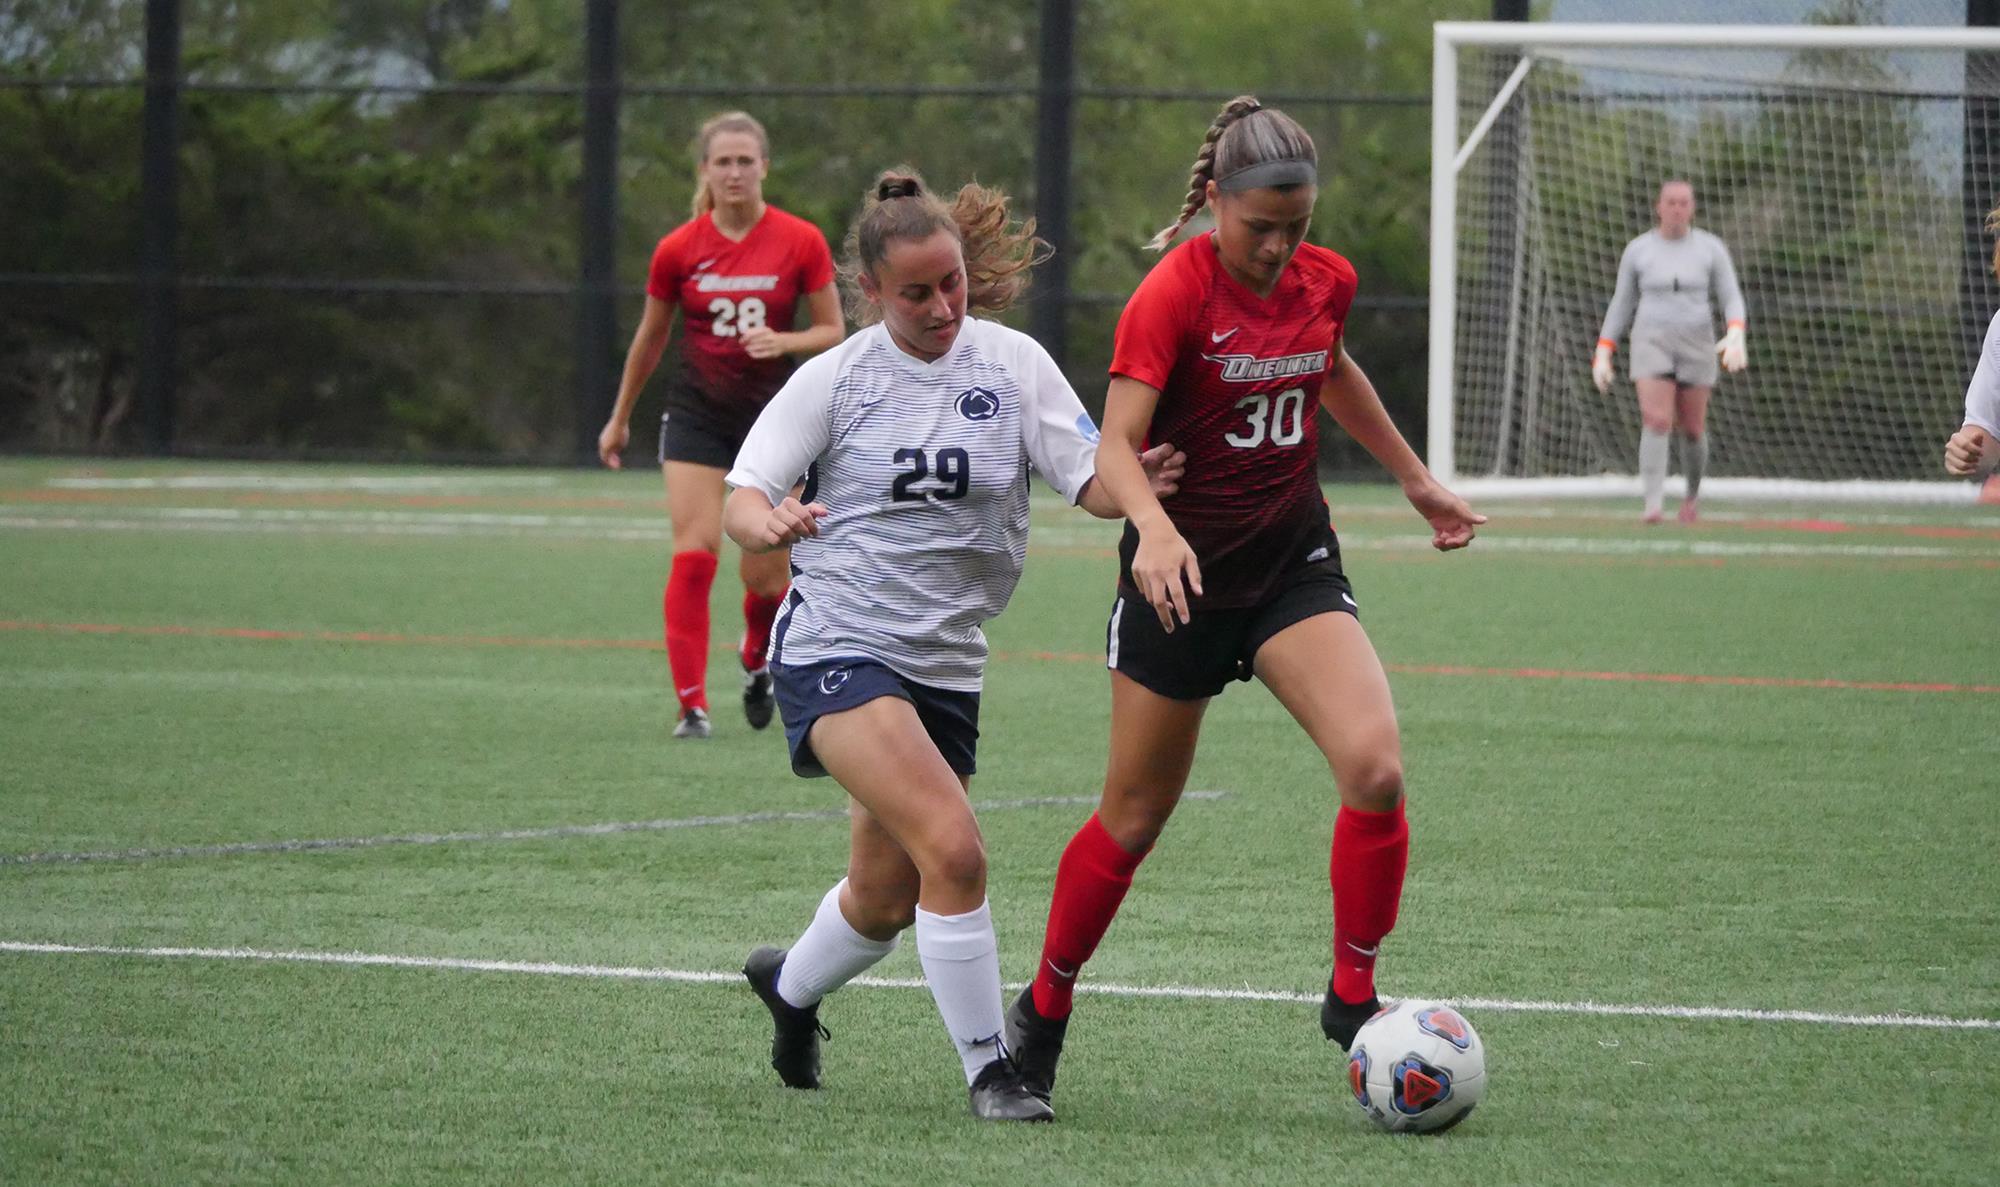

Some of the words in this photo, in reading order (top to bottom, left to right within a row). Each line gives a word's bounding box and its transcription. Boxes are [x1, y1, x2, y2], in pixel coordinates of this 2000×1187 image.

[708, 297, 766, 337] 28
[1225, 388, 1305, 448] 30
[893, 447, 969, 502] 29
